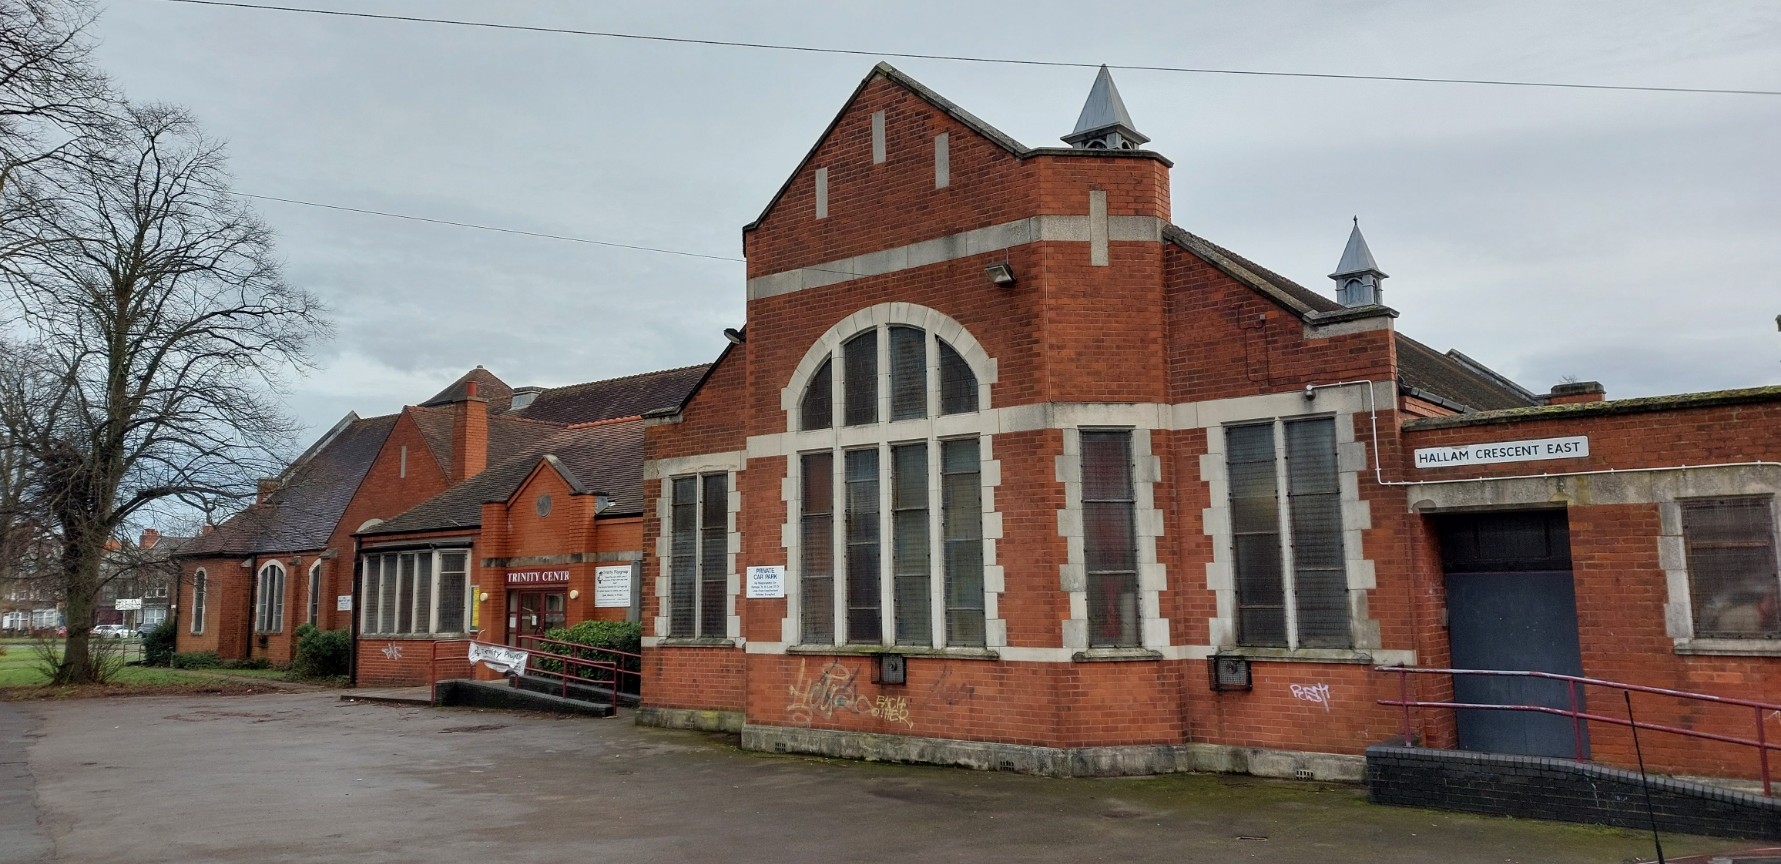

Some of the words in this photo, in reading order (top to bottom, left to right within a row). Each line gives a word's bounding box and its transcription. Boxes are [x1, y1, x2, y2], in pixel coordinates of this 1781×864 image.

[1419, 450, 1469, 463] HALLAM
[1475, 444, 1540, 459] CRESCENT
[1547, 441, 1581, 454] EAST
[507, 571, 540, 583] TRINITY
